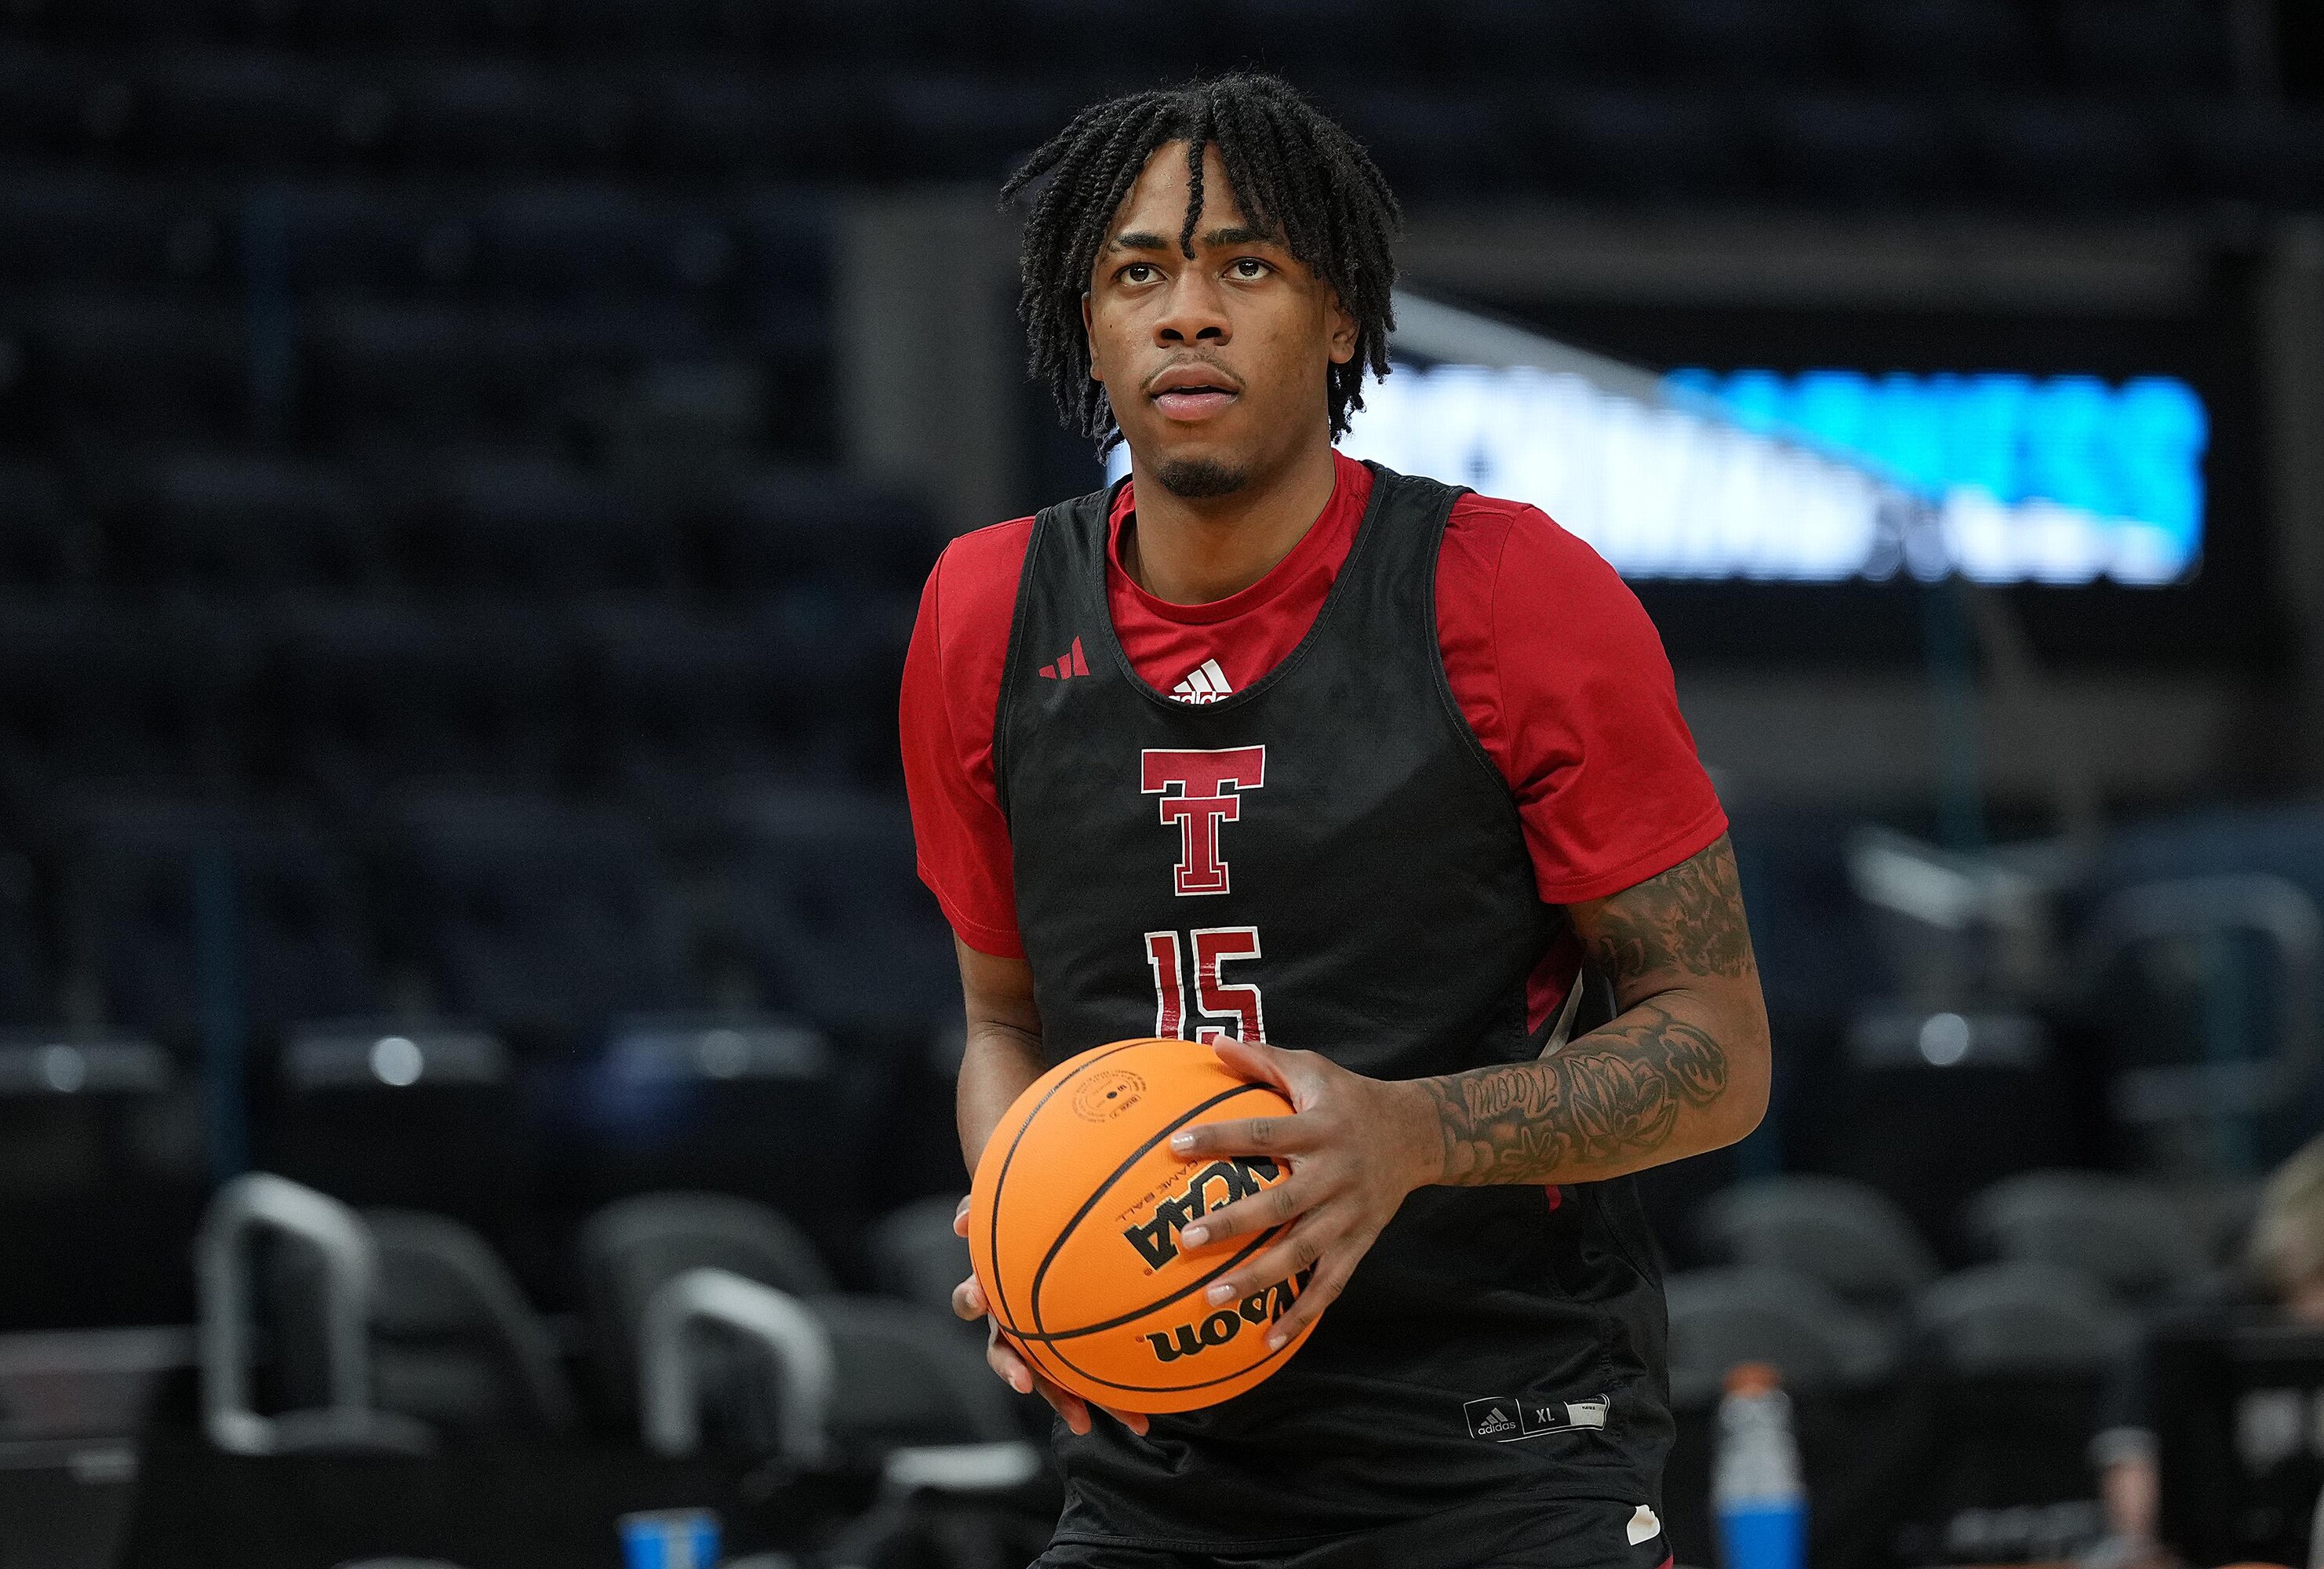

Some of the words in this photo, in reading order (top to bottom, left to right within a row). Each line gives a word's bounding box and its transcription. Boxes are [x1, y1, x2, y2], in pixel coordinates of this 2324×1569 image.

[1144, 926, 1267, 1044] 15
[1155, 1159, 1199, 1196] GAME
[1115, 1190, 1157, 1223] BALL
[1122, 1155, 1280, 1272] NCAA
[1478, 1420, 1516, 1436] adidas
[1536, 1407, 1555, 1424] XL
